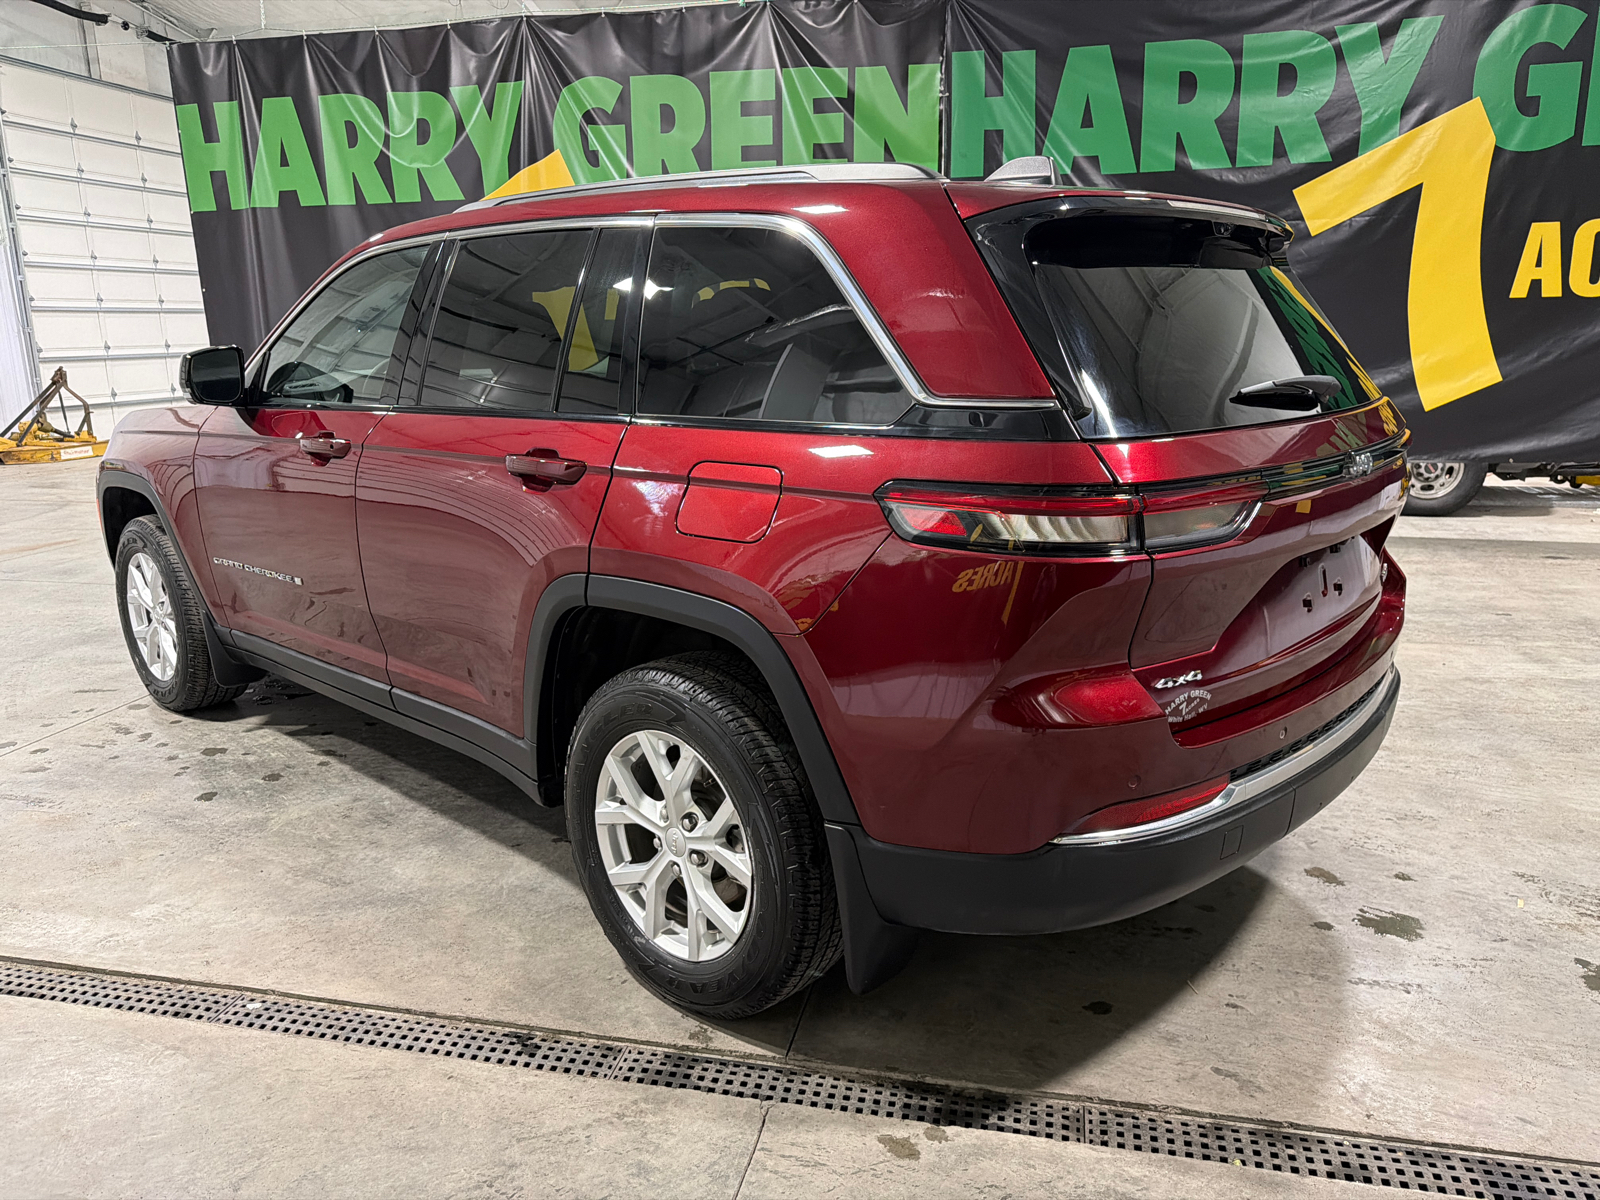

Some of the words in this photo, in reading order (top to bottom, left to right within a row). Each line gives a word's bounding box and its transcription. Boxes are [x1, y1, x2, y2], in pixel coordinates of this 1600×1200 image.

[951, 15, 1444, 186] HARRY
[176, 80, 525, 213] HARRY
[552, 63, 941, 184] GREEN
[1292, 96, 1503, 412] 7
[213, 557, 243, 569] GRAND
[244, 564, 293, 583] CHEROKEE
[1164, 692, 1189, 715] HARRY
[1190, 689, 1212, 701] GREEN
[1168, 715, 1183, 723] White
[1198, 703, 1208, 714] WV
[1179, 701, 1187, 716] 7
